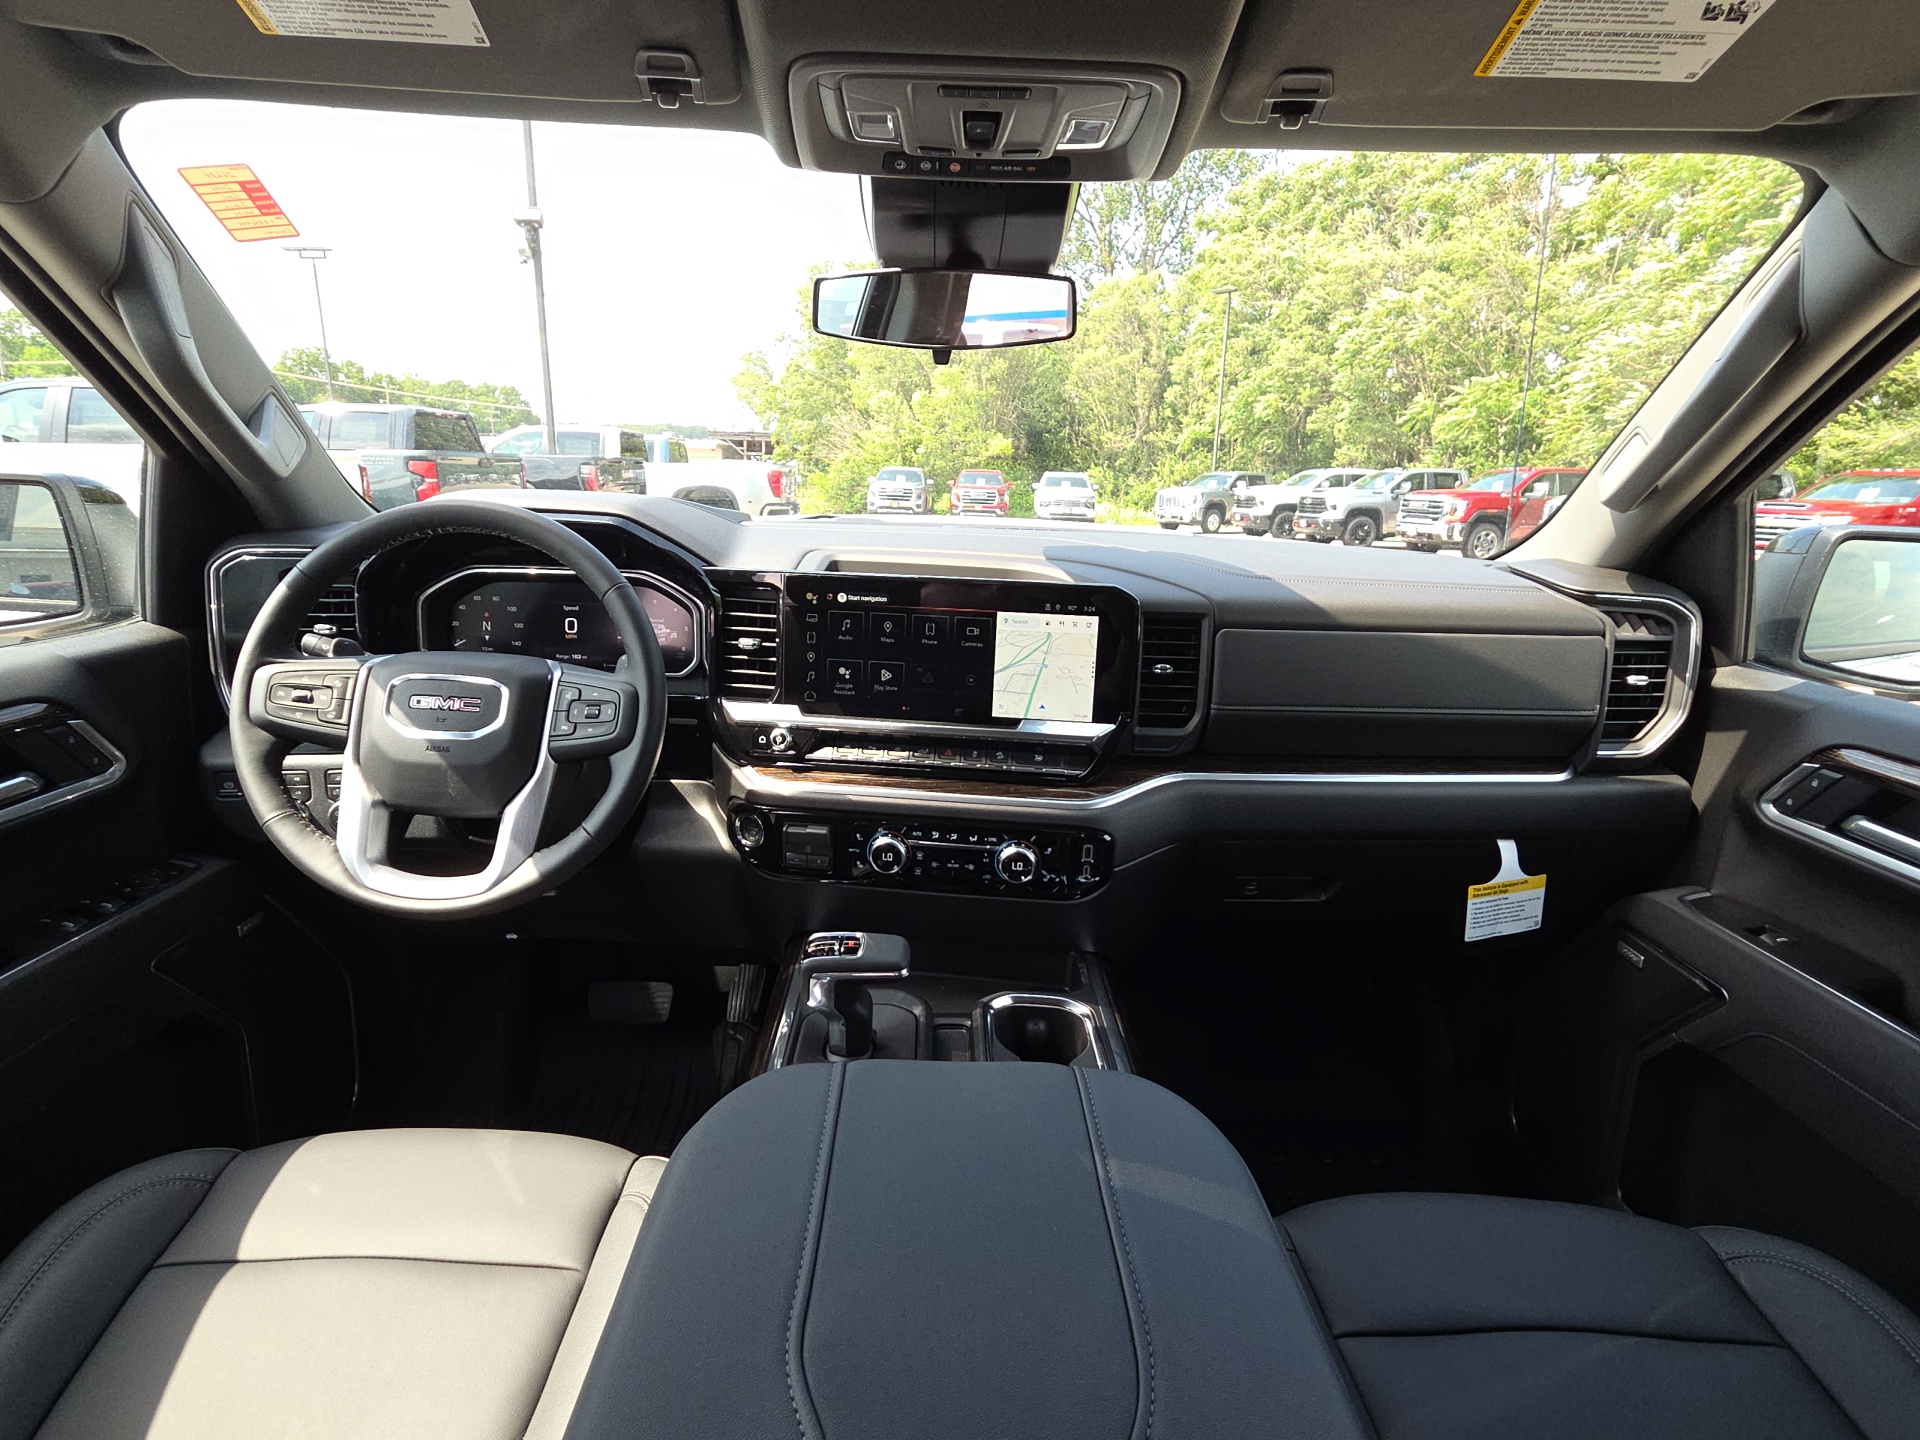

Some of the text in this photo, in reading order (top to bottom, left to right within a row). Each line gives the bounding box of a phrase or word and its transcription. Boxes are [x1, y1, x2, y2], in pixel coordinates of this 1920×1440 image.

[1652, 33, 1707, 41] INTELLIGENTS
[1480, 27, 1517, 74] AVERTISSEMENT
[482, 620, 491, 632] N
[564, 617, 578, 634] 0
[408, 694, 482, 712] GMC
[425, 745, 451, 753] AIRBAG
[882, 852, 893, 861] LO
[1011, 861, 1023, 871] LO
